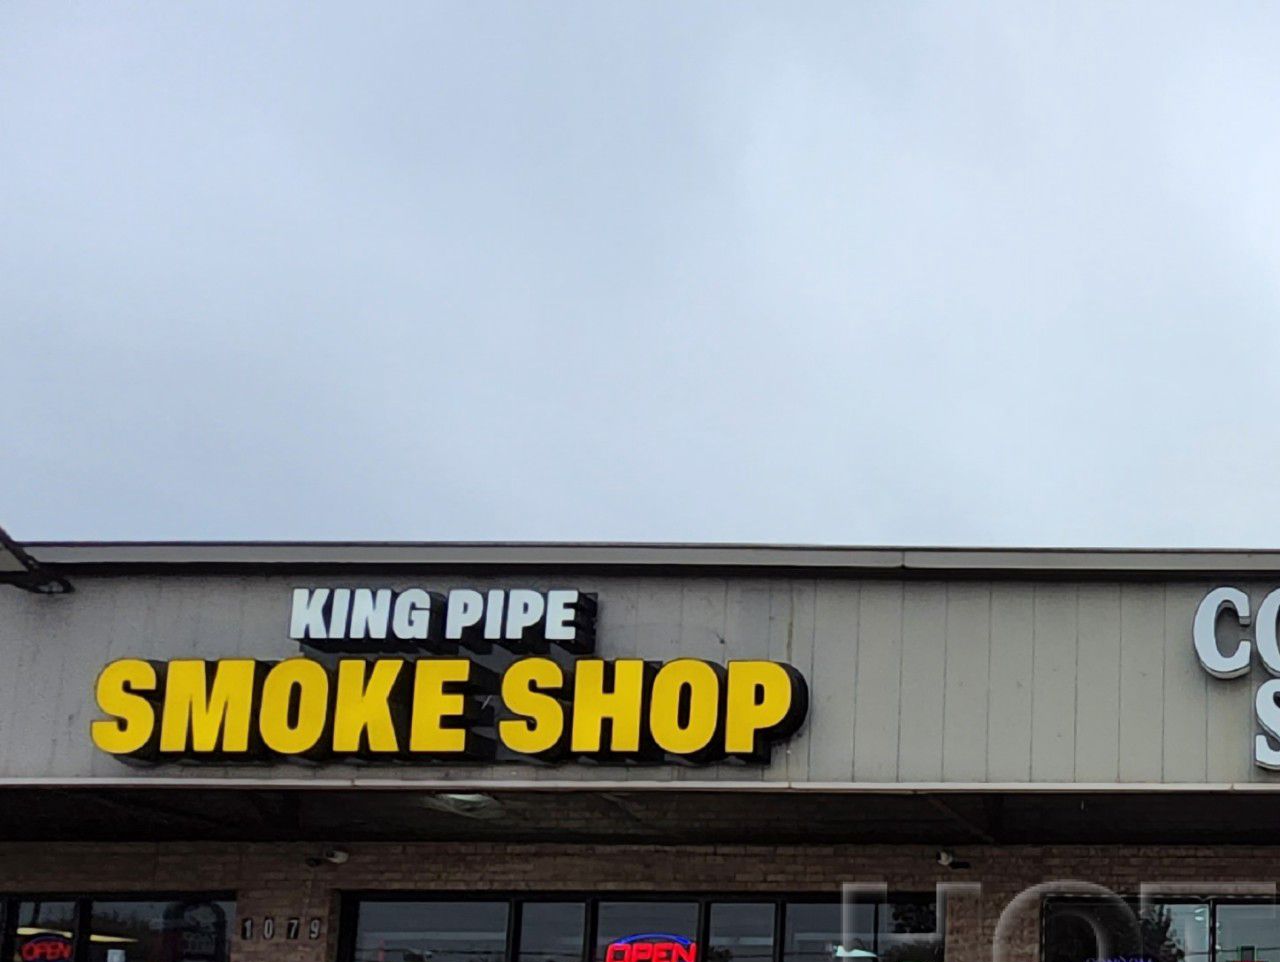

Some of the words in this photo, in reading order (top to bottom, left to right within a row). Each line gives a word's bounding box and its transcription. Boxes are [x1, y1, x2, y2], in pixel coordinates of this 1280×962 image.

[289, 588, 431, 640] KING
[445, 588, 579, 641] PIPE
[90, 658, 471, 755] SMOKE
[499, 658, 793, 755] SHOP
[241, 918, 323, 940] 1079
[22, 941, 73, 961] OPEN
